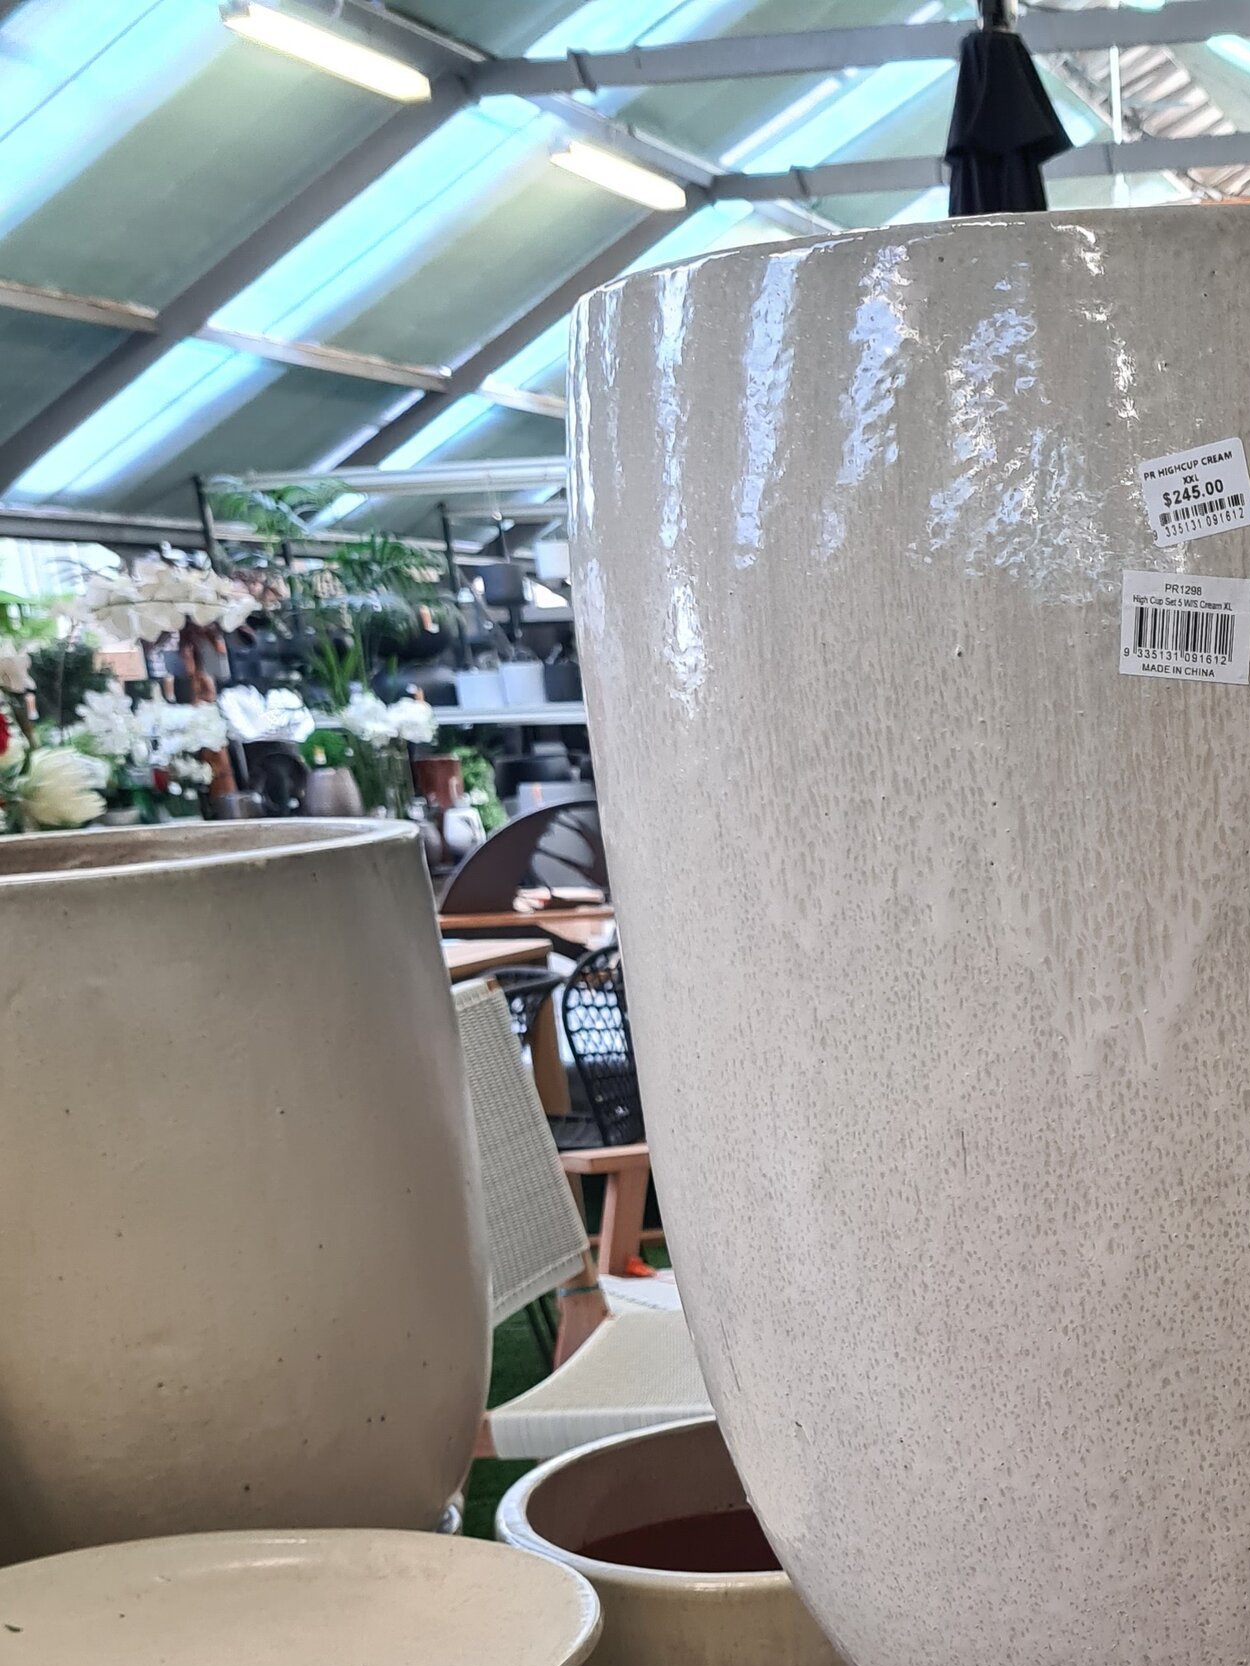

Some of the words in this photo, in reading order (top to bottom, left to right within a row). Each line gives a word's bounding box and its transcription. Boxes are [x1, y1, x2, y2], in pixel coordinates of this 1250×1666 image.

[1143, 471, 1156, 481] PR
[1158, 460, 1199, 477] HIGHCUP
[1201, 451, 1233, 466] CREAM
[1183, 474, 1199, 485] XXL
[1162, 479, 1224, 508] $245.00
[1165, 583, 1202, 596] PR1298
[1133, 594, 1148, 606] High
[1165, 597, 1177, 607] Set
[1200, 600, 1222, 611] Cream
[1223, 602, 1233, 611] XL
[1142, 663, 1171, 674] MADE
[1172, 666, 1182, 675] IN
[1184, 667, 1215, 677] CHINA
